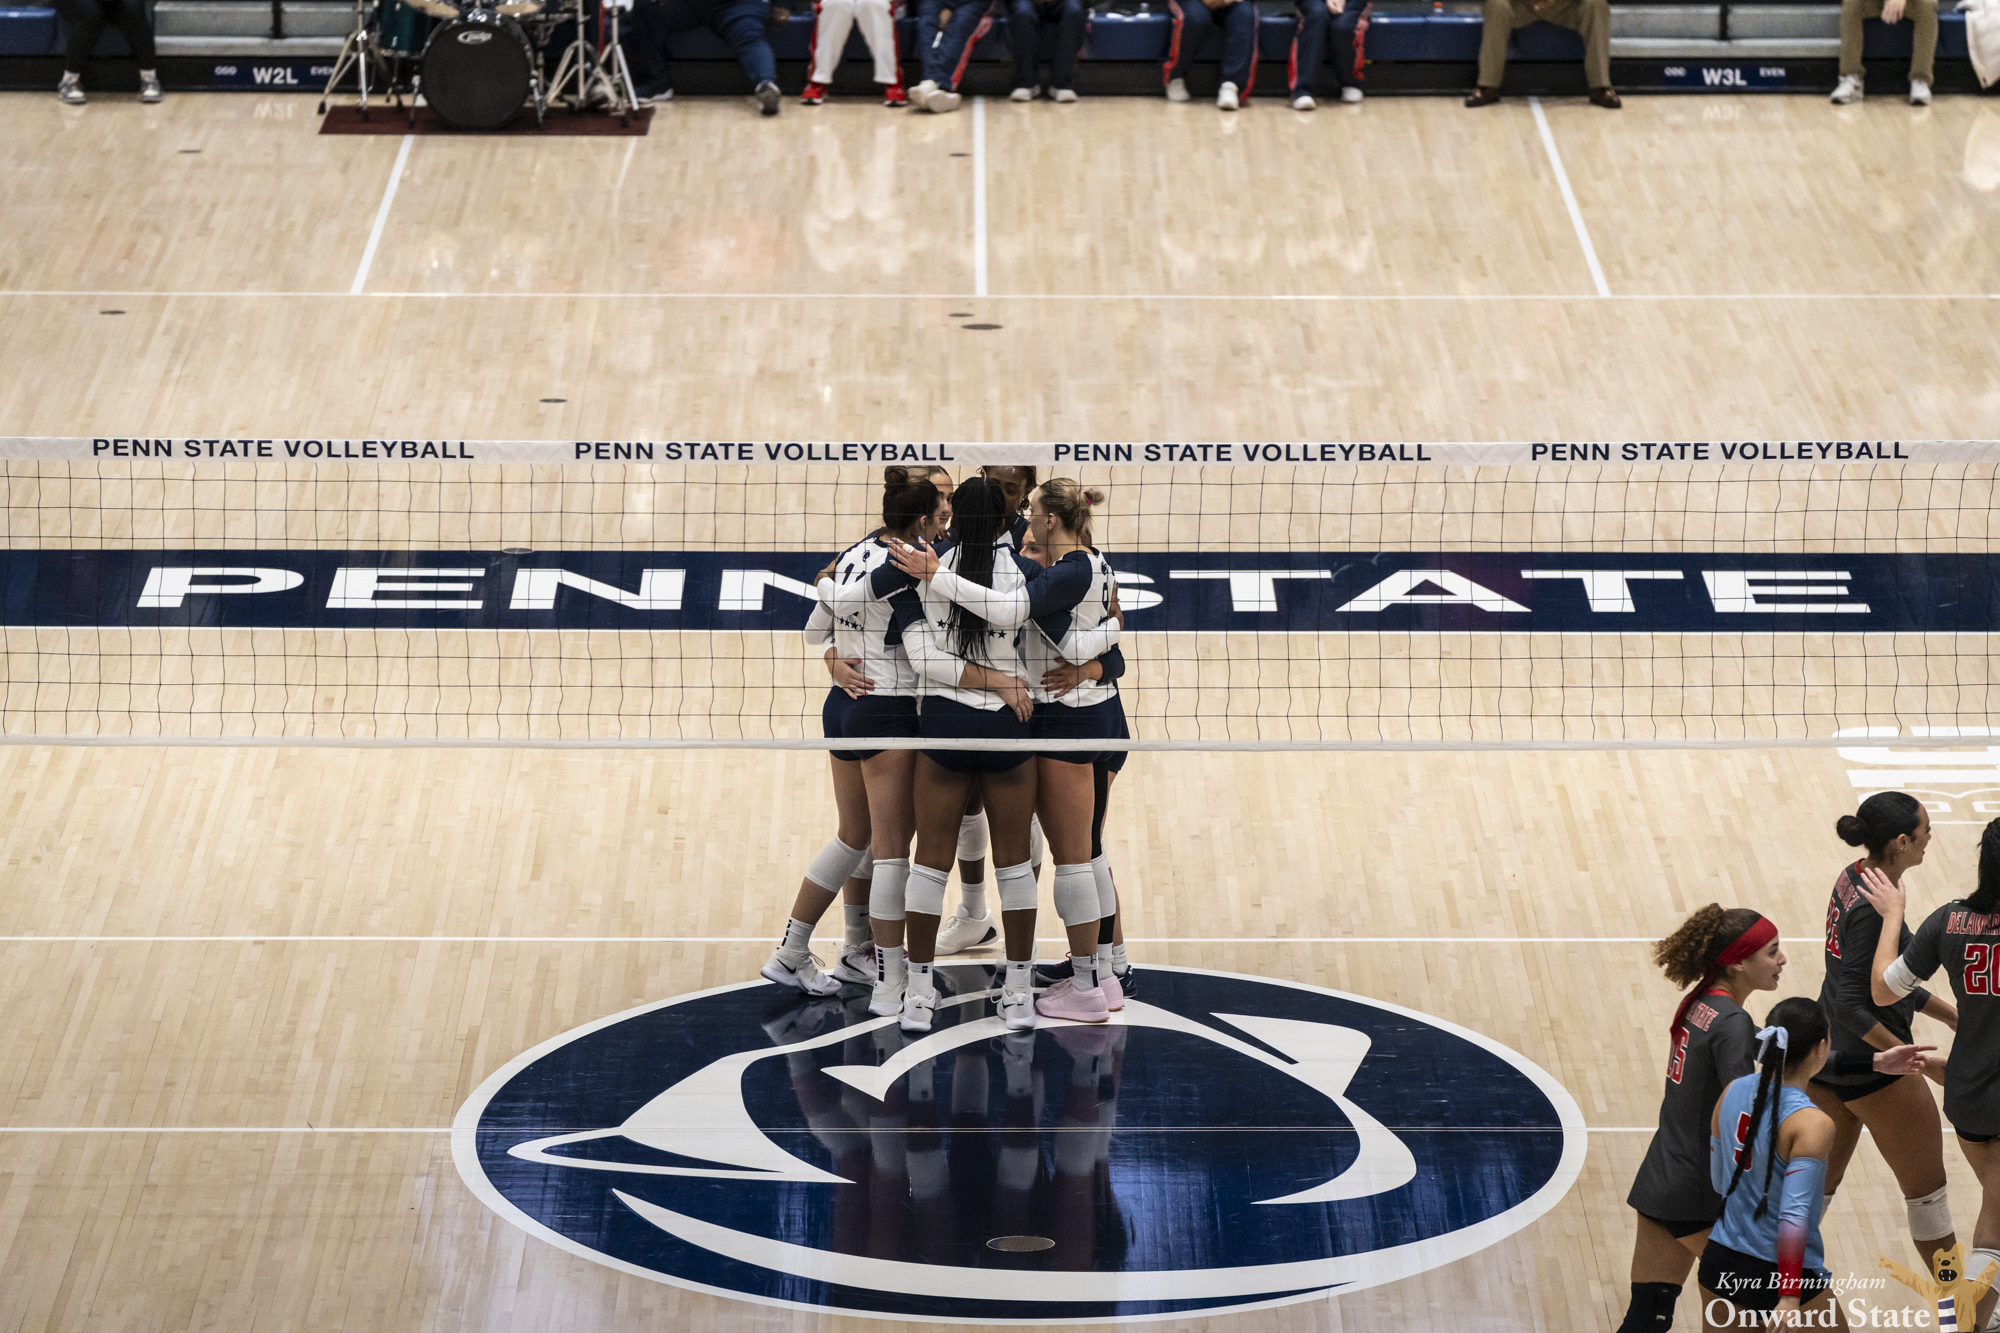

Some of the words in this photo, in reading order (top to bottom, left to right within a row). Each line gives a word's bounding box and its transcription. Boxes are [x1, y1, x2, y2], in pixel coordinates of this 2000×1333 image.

[252, 67, 299, 85] W2L
[1702, 67, 1748, 86] W3L
[1759, 67, 1786, 77] EVEN
[93, 439, 172, 457] PENN
[184, 439, 273, 458] STATE
[284, 440, 475, 459] VOLLEYBALL
[575, 442, 654, 460] PENN
[665, 442, 754, 461] STATE
[764, 443, 955, 462] VOLLEYBALL
[1054, 443, 1132, 462] PENN
[1144, 443, 1232, 462] STATE
[1243, 443, 1432, 462] VOLLEYBALL
[1531, 442, 1610, 461] PENN
[1621, 442, 1709, 461] STATE
[1720, 441, 1909, 460] VOLLEYBALL
